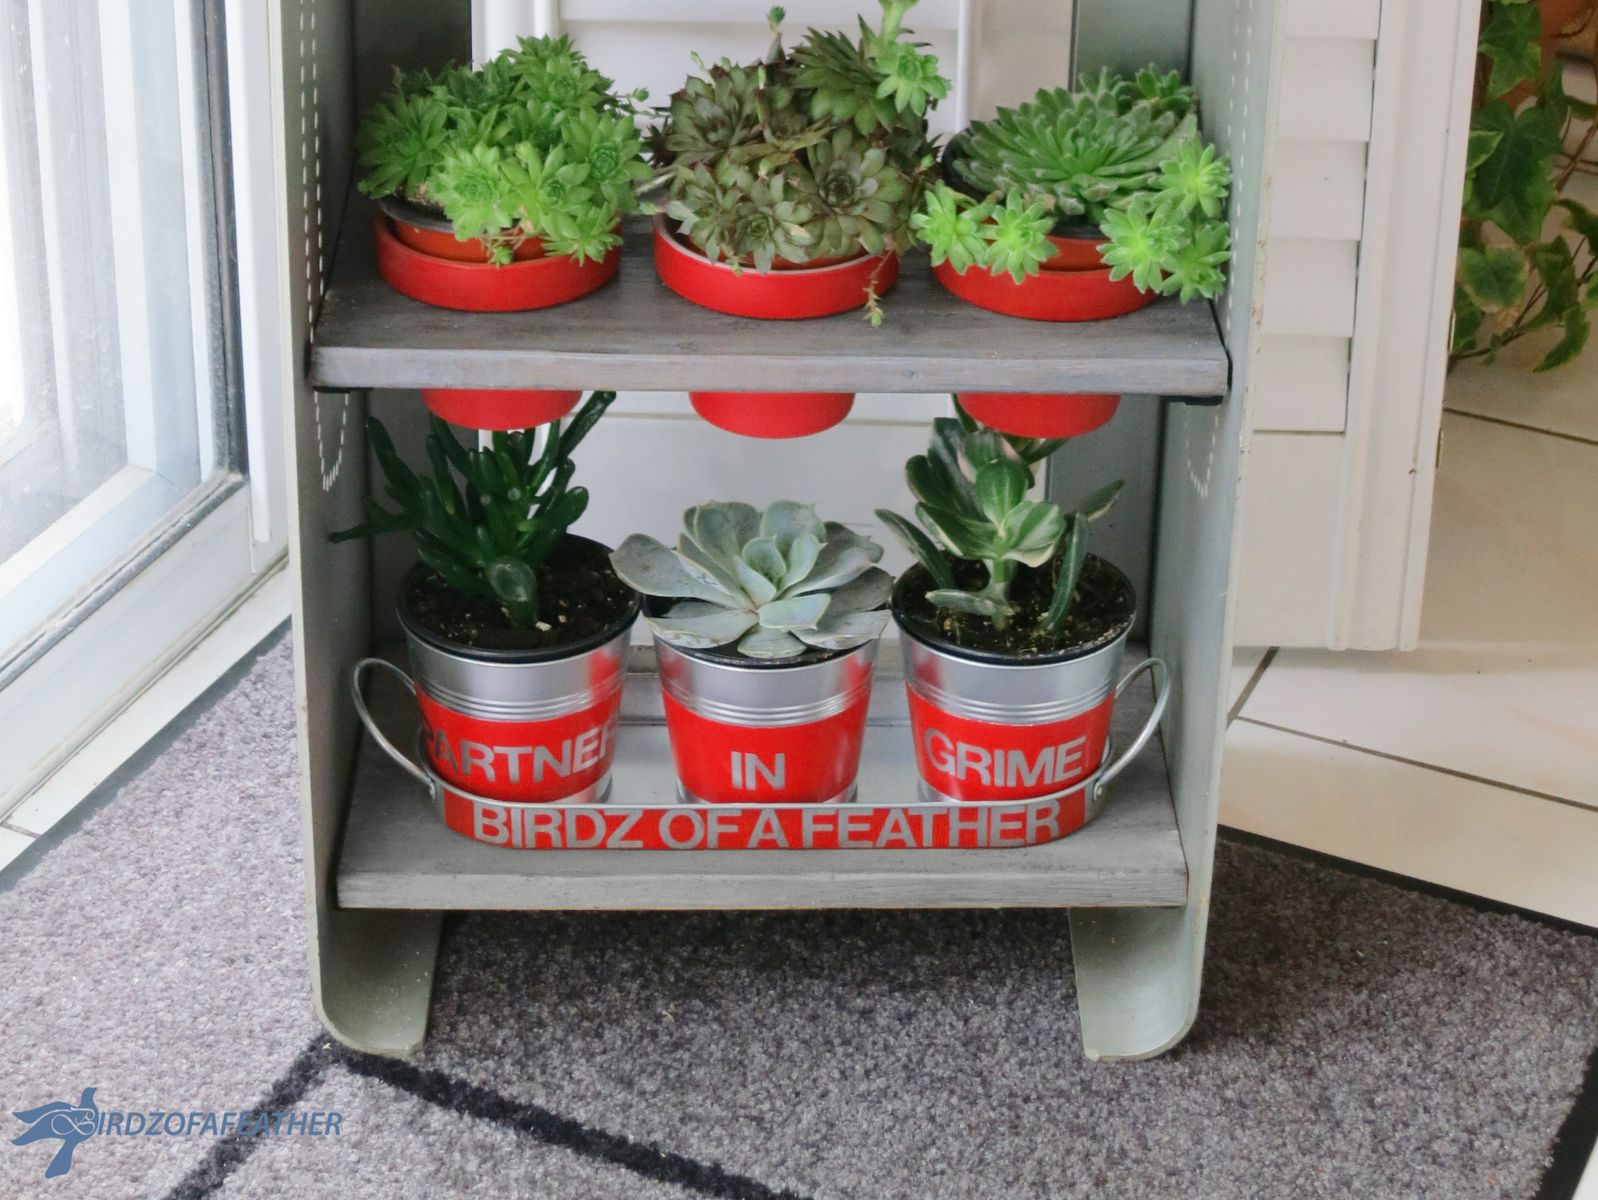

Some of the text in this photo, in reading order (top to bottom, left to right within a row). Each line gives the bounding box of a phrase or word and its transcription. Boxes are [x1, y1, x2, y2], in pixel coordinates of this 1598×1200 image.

[424, 720, 616, 784] ARTNE
[730, 751, 786, 791] IN
[924, 727, 1087, 788] GRIME
[473, 801, 644, 849] BIRDZ
[801, 799, 1061, 849] FEATHER
